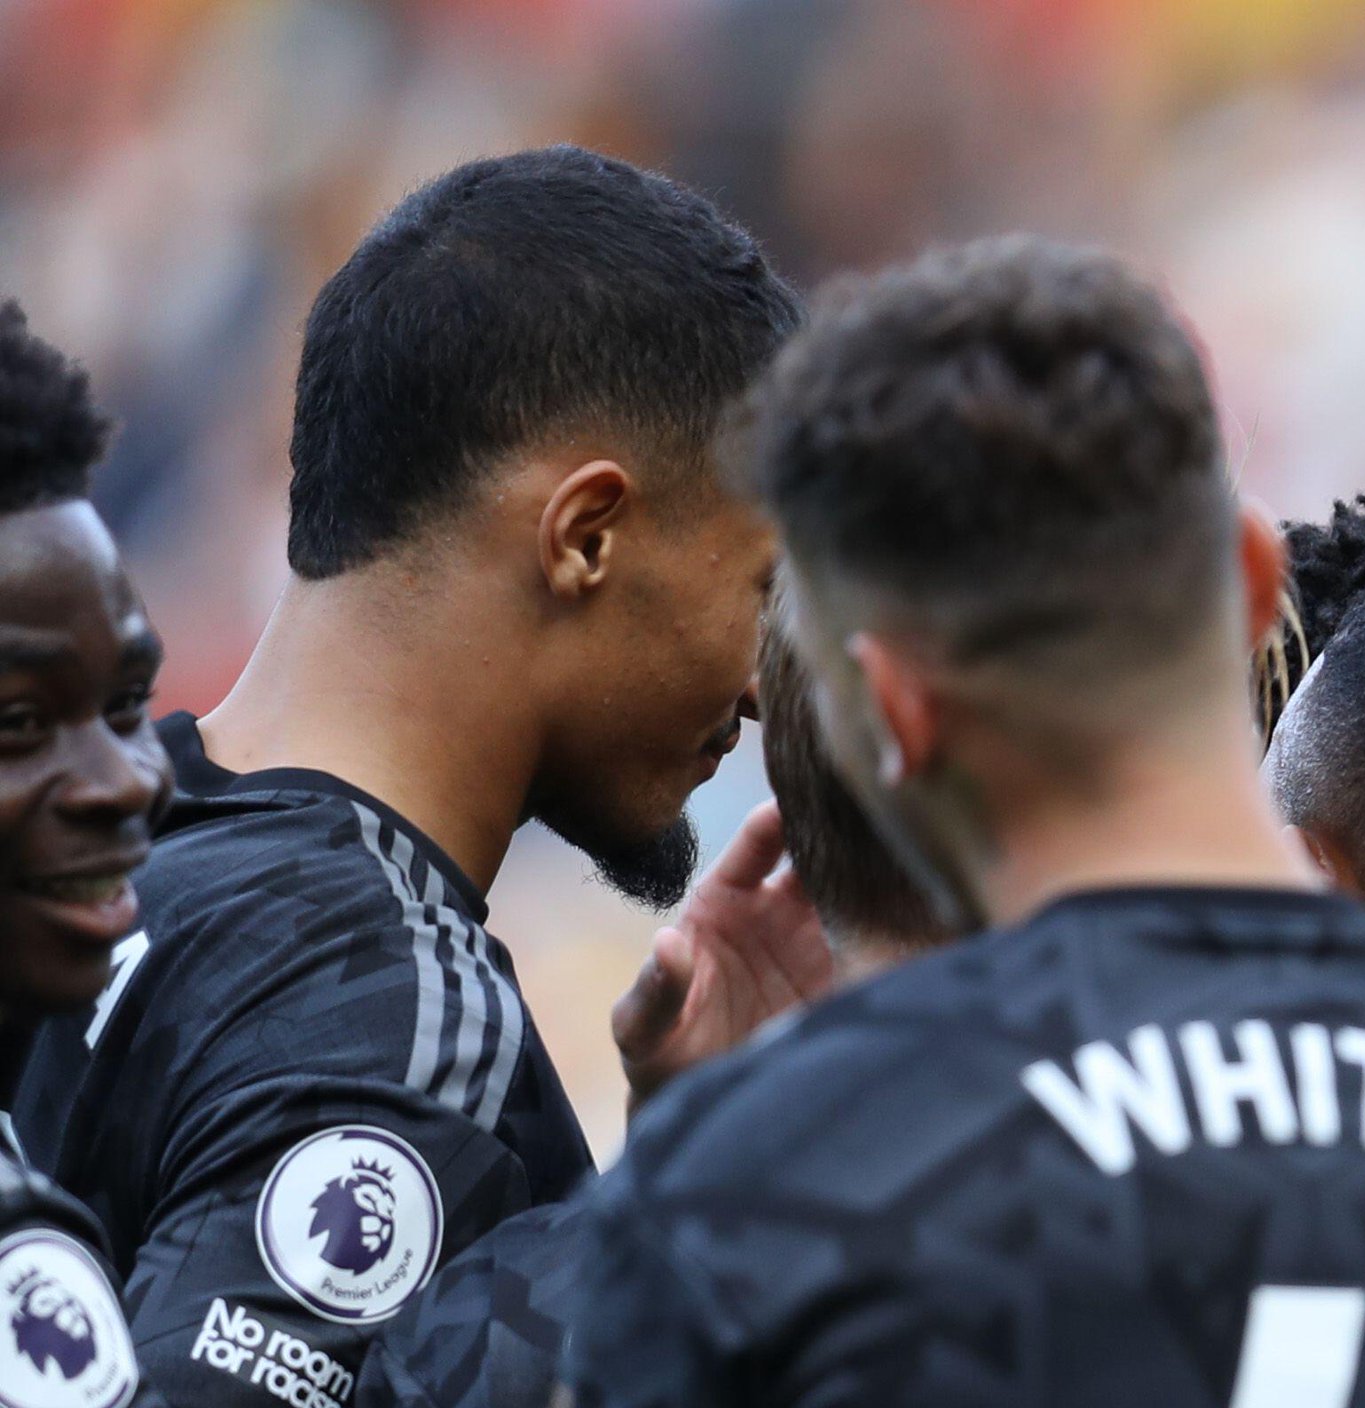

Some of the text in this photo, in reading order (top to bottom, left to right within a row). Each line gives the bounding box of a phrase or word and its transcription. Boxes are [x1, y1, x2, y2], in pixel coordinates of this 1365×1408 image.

[320, 1247, 413, 1300] Premier League
[190, 1328, 255, 1374] for
[201, 1297, 354, 1401] No room
